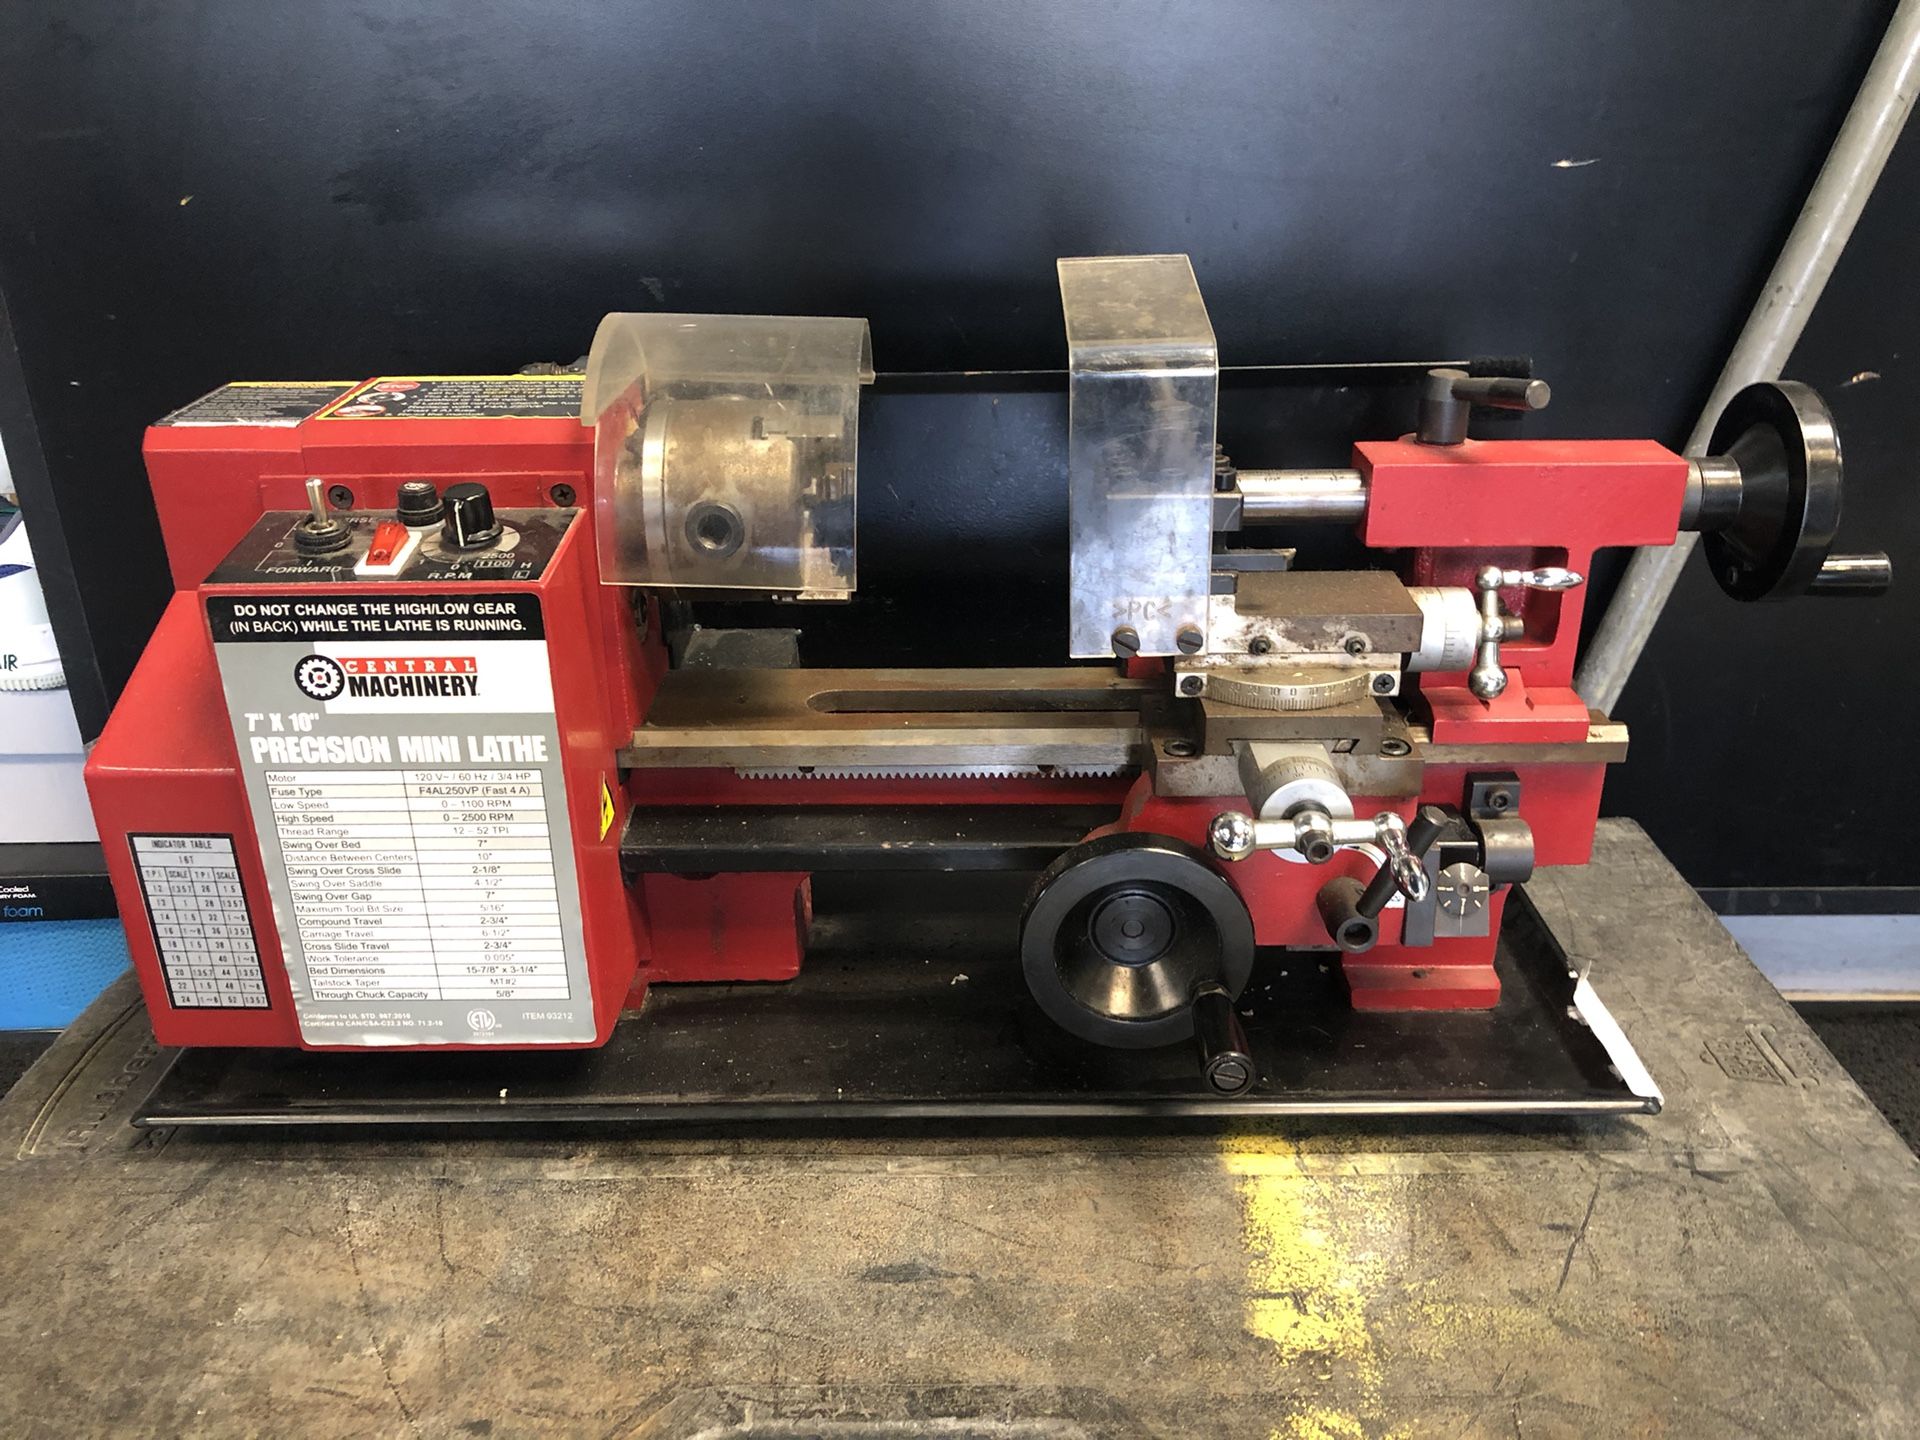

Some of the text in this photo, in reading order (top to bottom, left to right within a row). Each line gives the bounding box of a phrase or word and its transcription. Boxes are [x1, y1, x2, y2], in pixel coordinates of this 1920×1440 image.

[265, 566, 342, 574] FORWARD
[234, 603, 516, 616] DO NOT CHANGE THE HIGH/LOW GEAR
[230, 619, 526, 634] (IN BACK) WHILE THE LATHE IS RUNNING.
[345, 659, 476, 673] CENTRAL
[348, 675, 481, 698] MACHINERY
[1290, 687, 1297, 696] 0
[250, 735, 548, 764] PRECISION MINI LATHE
[268, 774, 296, 782] Motor
[415, 773, 432, 781] 120
[459, 773, 471, 781] 60
[474, 773, 487, 781] Hz
[516, 772, 531, 780] HP
[271, 788, 322, 797] Fuse Type
[419, 786, 479, 795] F4AL250VP
[482, 786, 507, 795] (Fast
[519, 787, 530, 795] A)
[297, 801, 329, 810] Speed
[461, 800, 484, 808] 1100
[487, 799, 512, 807] RPM
[277, 814, 334, 824] High Speed
[462, 813, 486, 821] 2500
[490, 813, 514, 821] RPM
[317, 828, 349, 838] Range
[152, 840, 212, 849] INDICATOR TABLE
[283, 841, 312, 851] Swing
[285, 854, 327, 862] Distance
[375, 853, 413, 861] Centers
[288, 867, 318, 877] Swing
[346, 866, 375, 874] Cross
[378, 866, 402, 874] Slide
[291, 880, 320, 890] Swing
[294, 893, 323, 902] Swing
[351, 892, 372, 901] Gap
[4, 905, 43, 917] foam
[345, 905, 364, 913] Tool
[299, 918, 351, 927] Compound
[302, 931, 342, 940] Carriage
[334, 942, 358, 950] Slide
[361, 942, 390, 950] Travel
[355, 979, 380, 988] Taper
[315, 991, 428, 1000] Through Chuck Capacity
